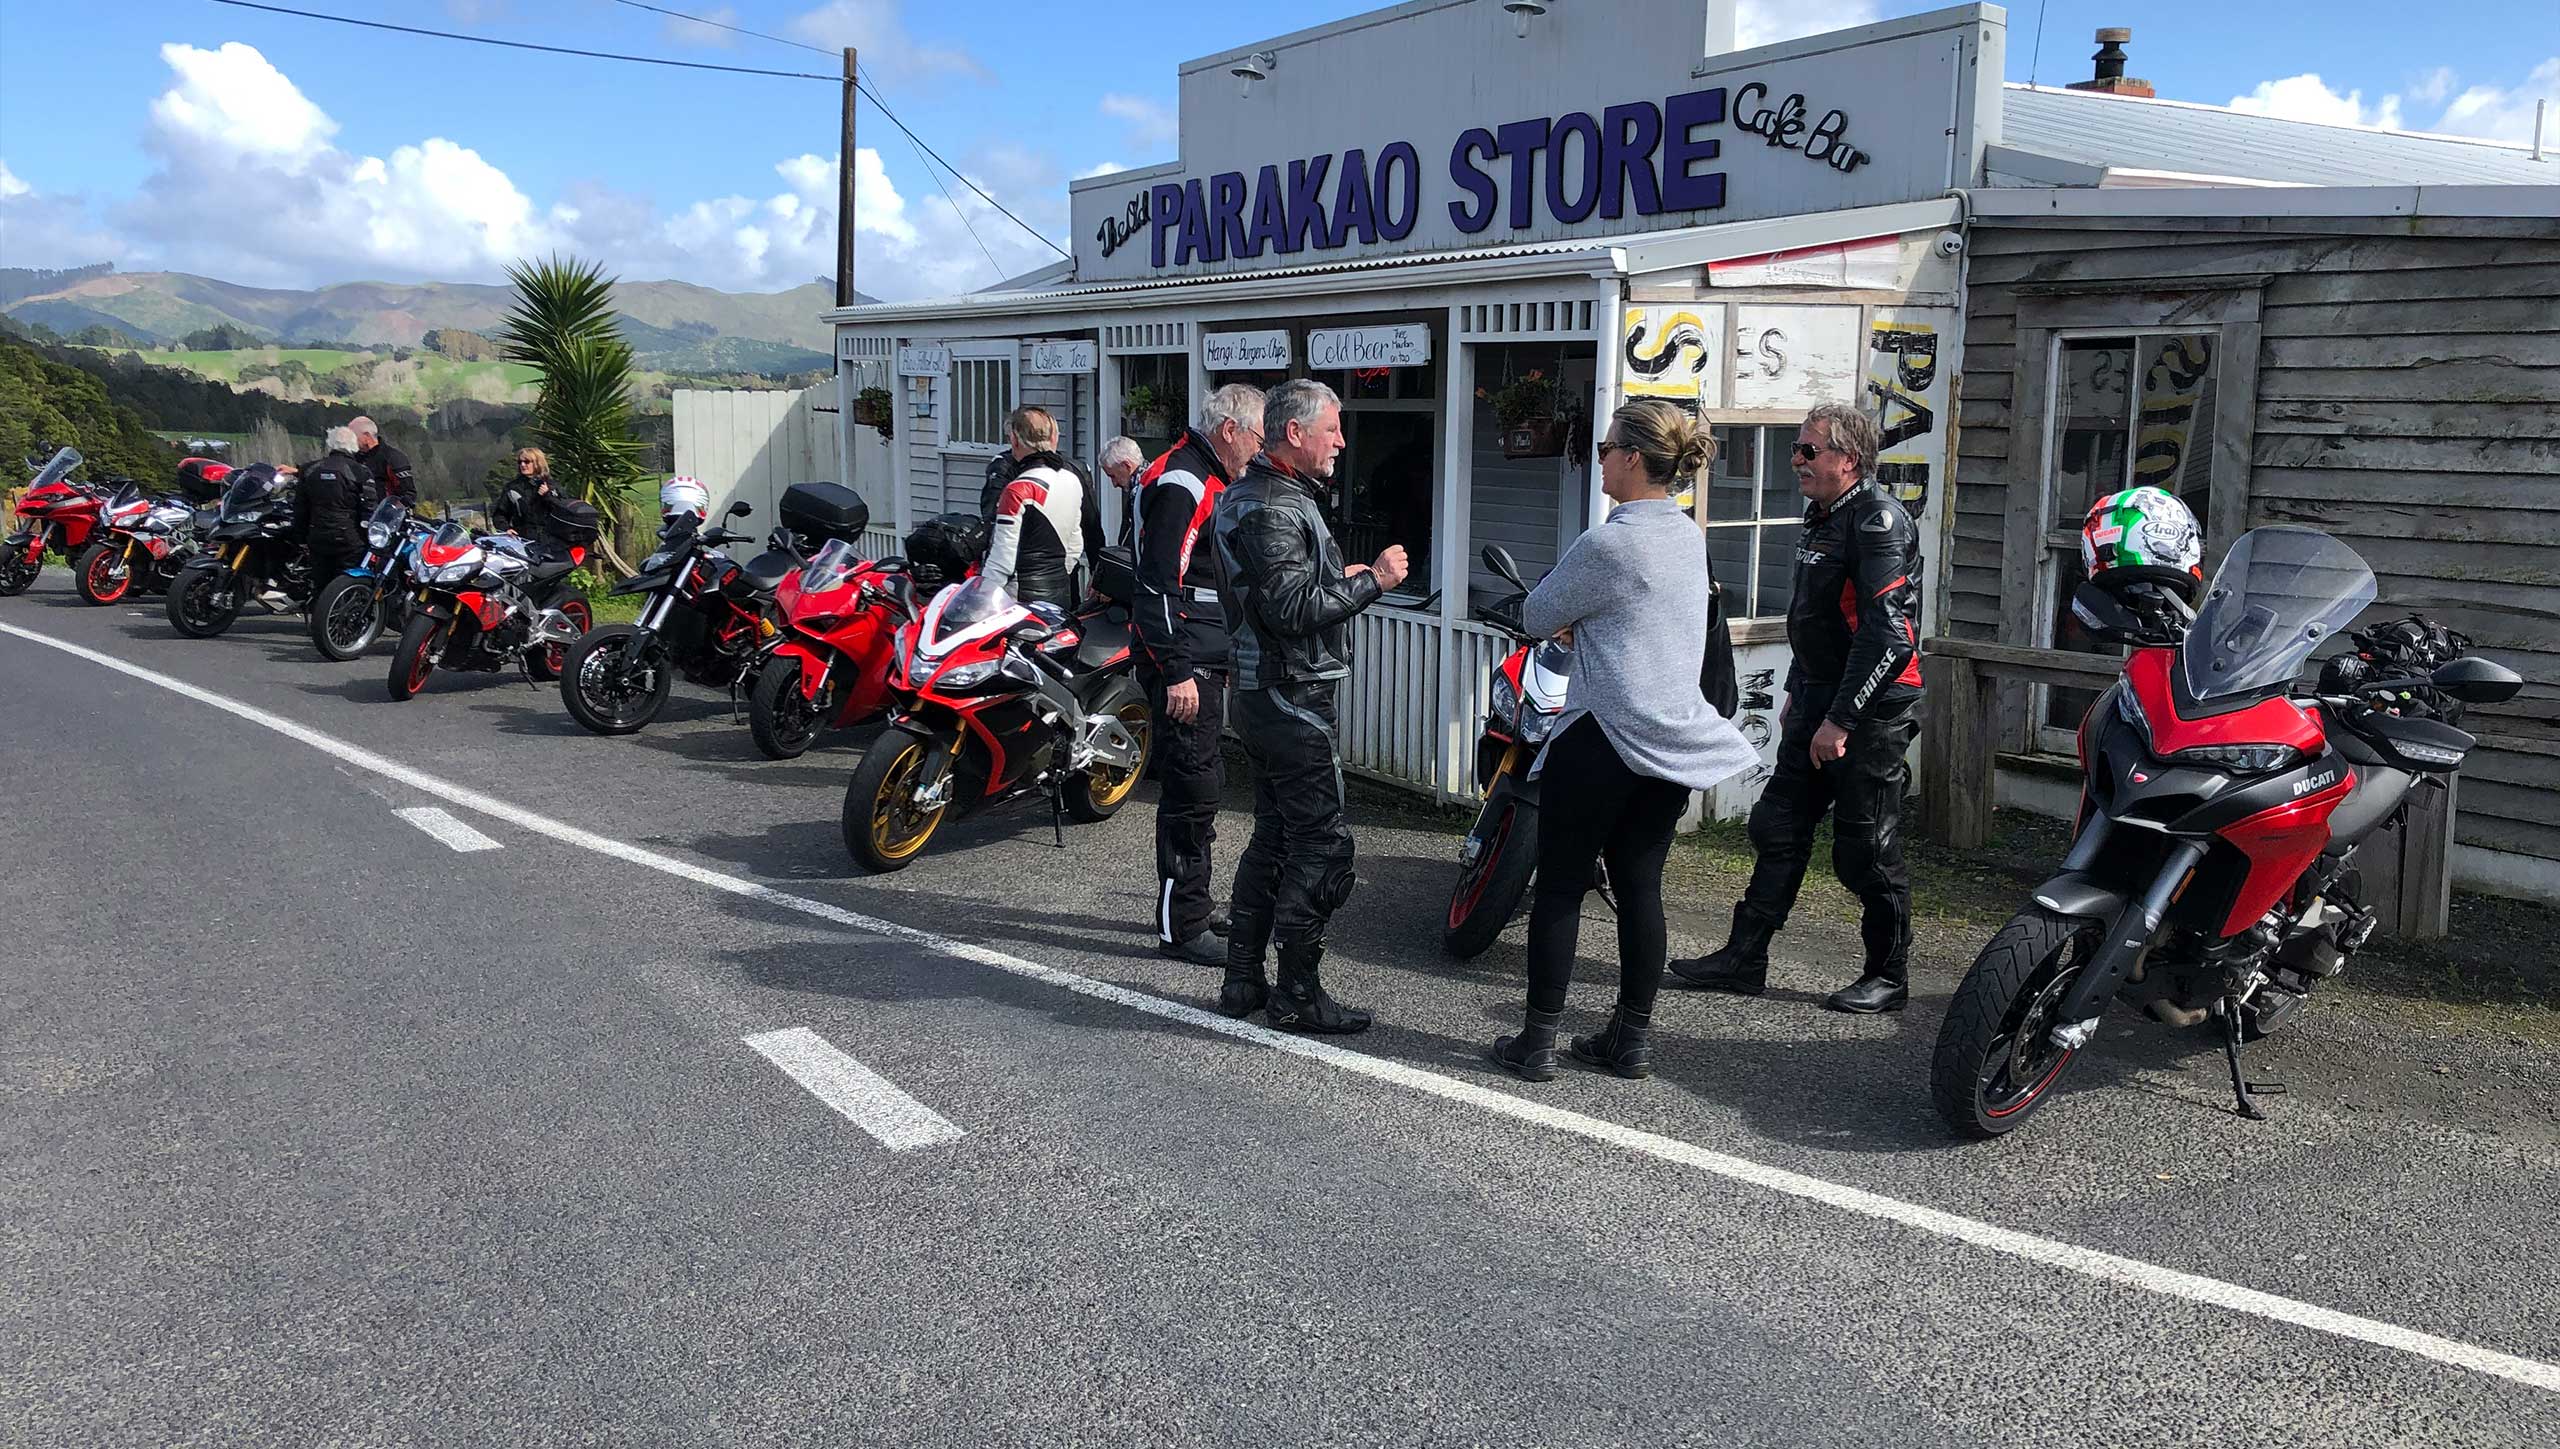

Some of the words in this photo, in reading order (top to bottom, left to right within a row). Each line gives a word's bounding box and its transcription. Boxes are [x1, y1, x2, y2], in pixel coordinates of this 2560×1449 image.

[1733, 82, 1807, 150] Café
[1804, 109, 1870, 173] Bar
[1151, 141, 1420, 268] PARAKAO
[1448, 87, 1727, 234] STORE
[1097, 216, 1129, 258] The
[1035, 346, 1063, 371] Coffee
[1069, 343, 1087, 369] Tea
[1311, 333, 1350, 366] Cold
[1353, 331, 1389, 363] Beer
[2150, 522, 2177, 536] Arai
[1854, 648, 1897, 710] DAINESE
[2292, 769, 2336, 796] DUCATI
